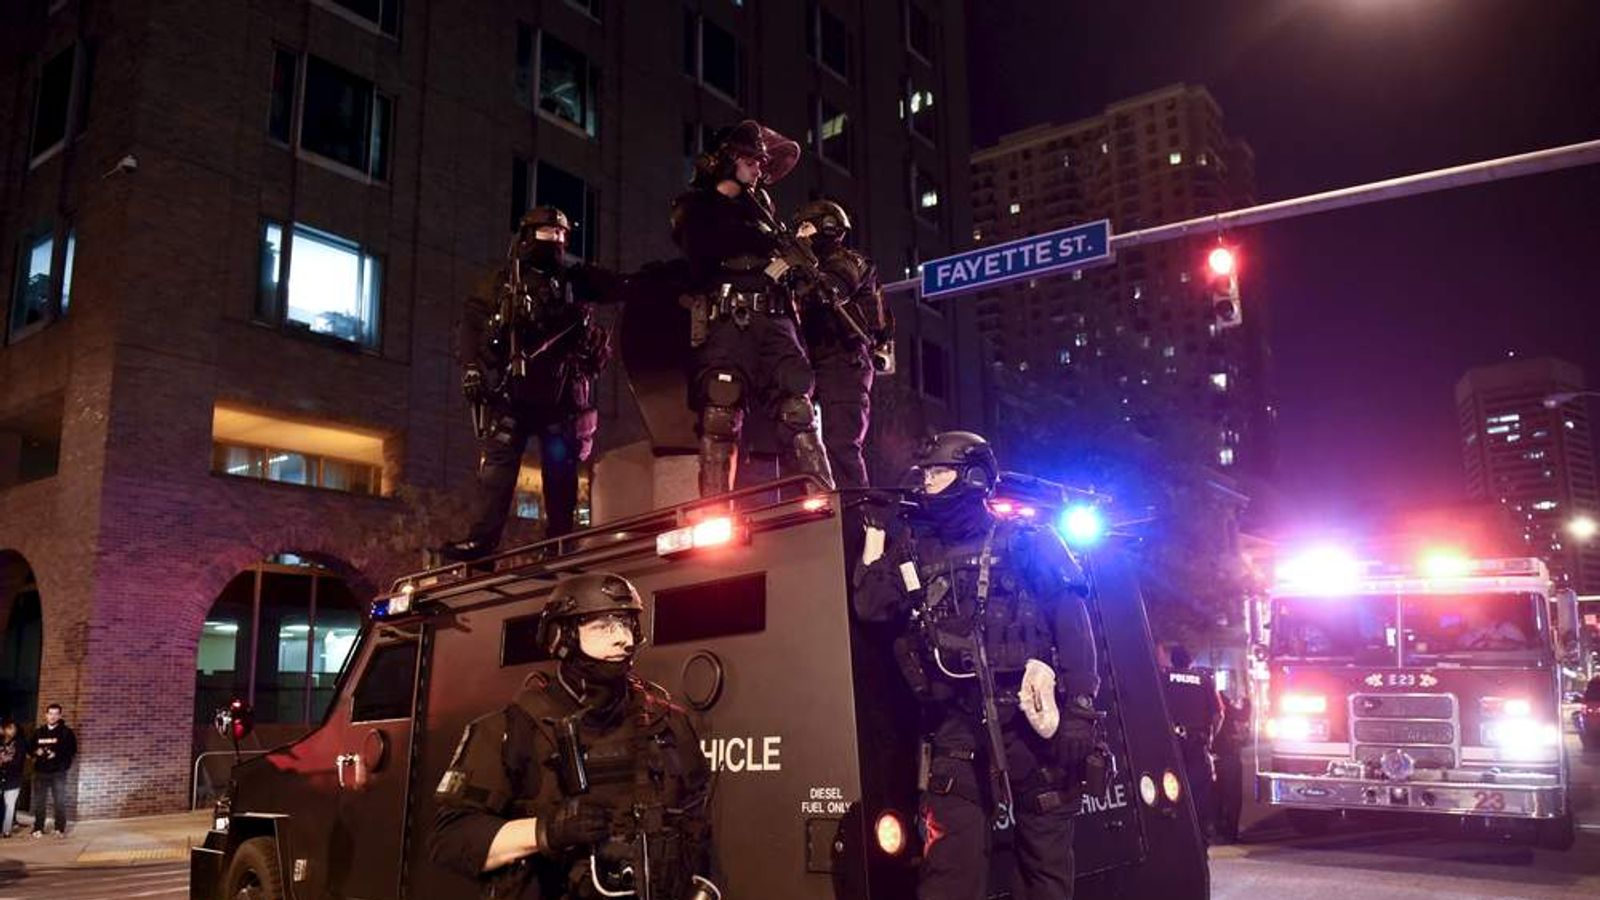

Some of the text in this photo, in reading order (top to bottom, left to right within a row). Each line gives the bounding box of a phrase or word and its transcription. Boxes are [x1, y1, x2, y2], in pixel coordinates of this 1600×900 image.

[936, 235, 1094, 287] FAYETTE ST.
[700, 736, 782, 772] HICLE
[809, 787, 844, 800] DIESEL
[1474, 791, 1505, 811] 23
[801, 801, 852, 814] FUEL ONLY
